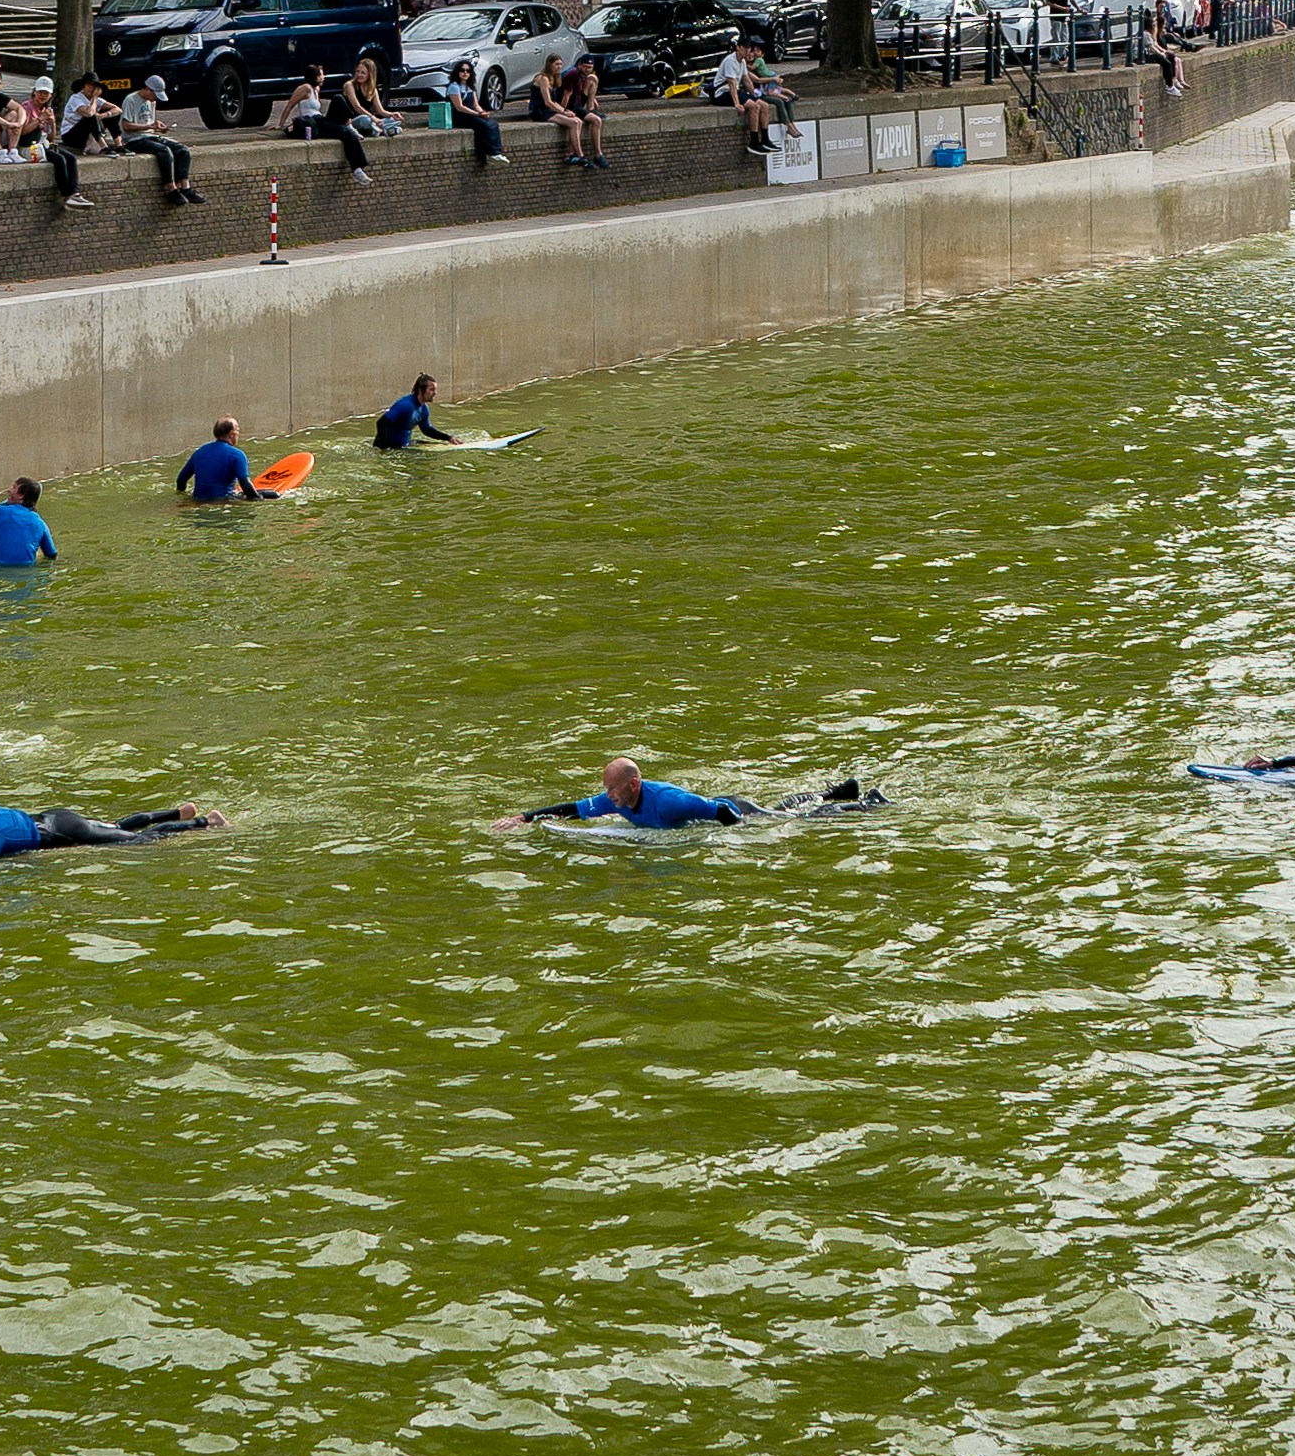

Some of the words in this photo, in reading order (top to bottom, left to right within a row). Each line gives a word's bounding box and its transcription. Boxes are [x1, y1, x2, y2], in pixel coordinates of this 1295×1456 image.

[968, 115, 1002, 126] PORSCHE
[875, 124, 913, 160] ZAPPLY
[785, 151, 813, 168] GROUP
